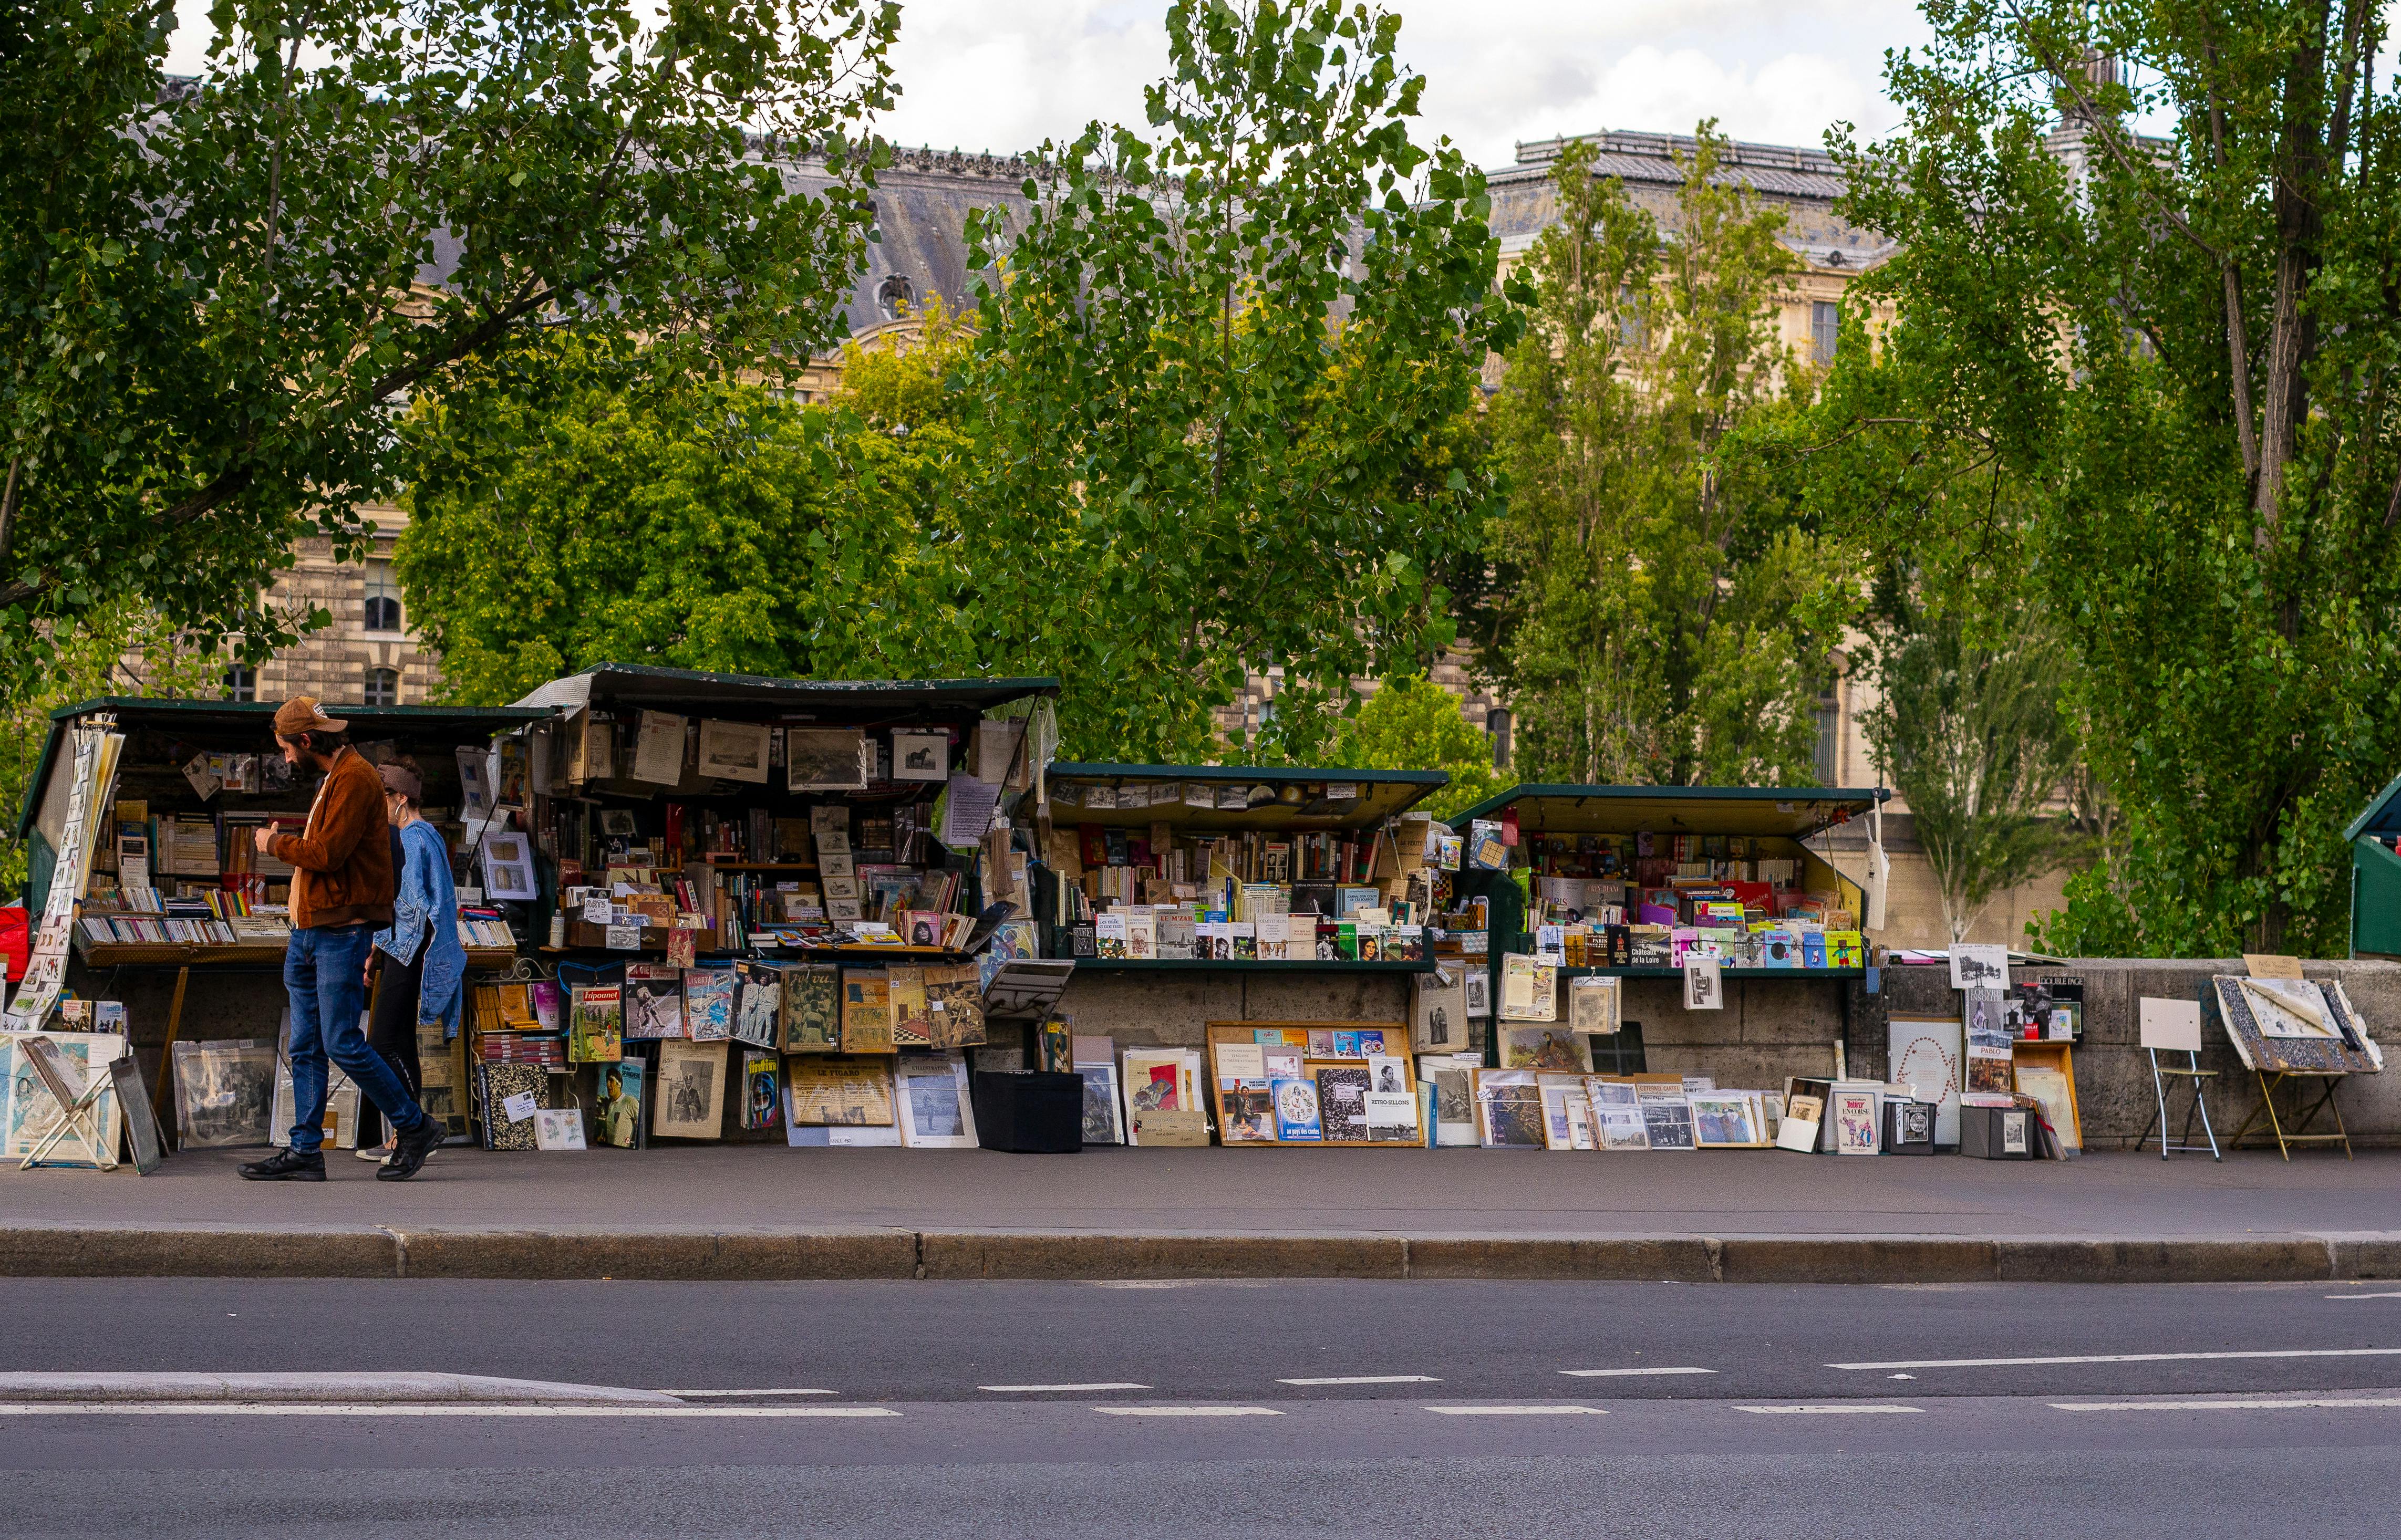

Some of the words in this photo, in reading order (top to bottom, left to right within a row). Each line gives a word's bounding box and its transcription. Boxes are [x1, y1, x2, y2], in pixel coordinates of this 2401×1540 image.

[586, 900, 606, 908] ARTS
[687, 975, 713, 984] LISETTE
[749, 1058, 777, 1074] tintin
